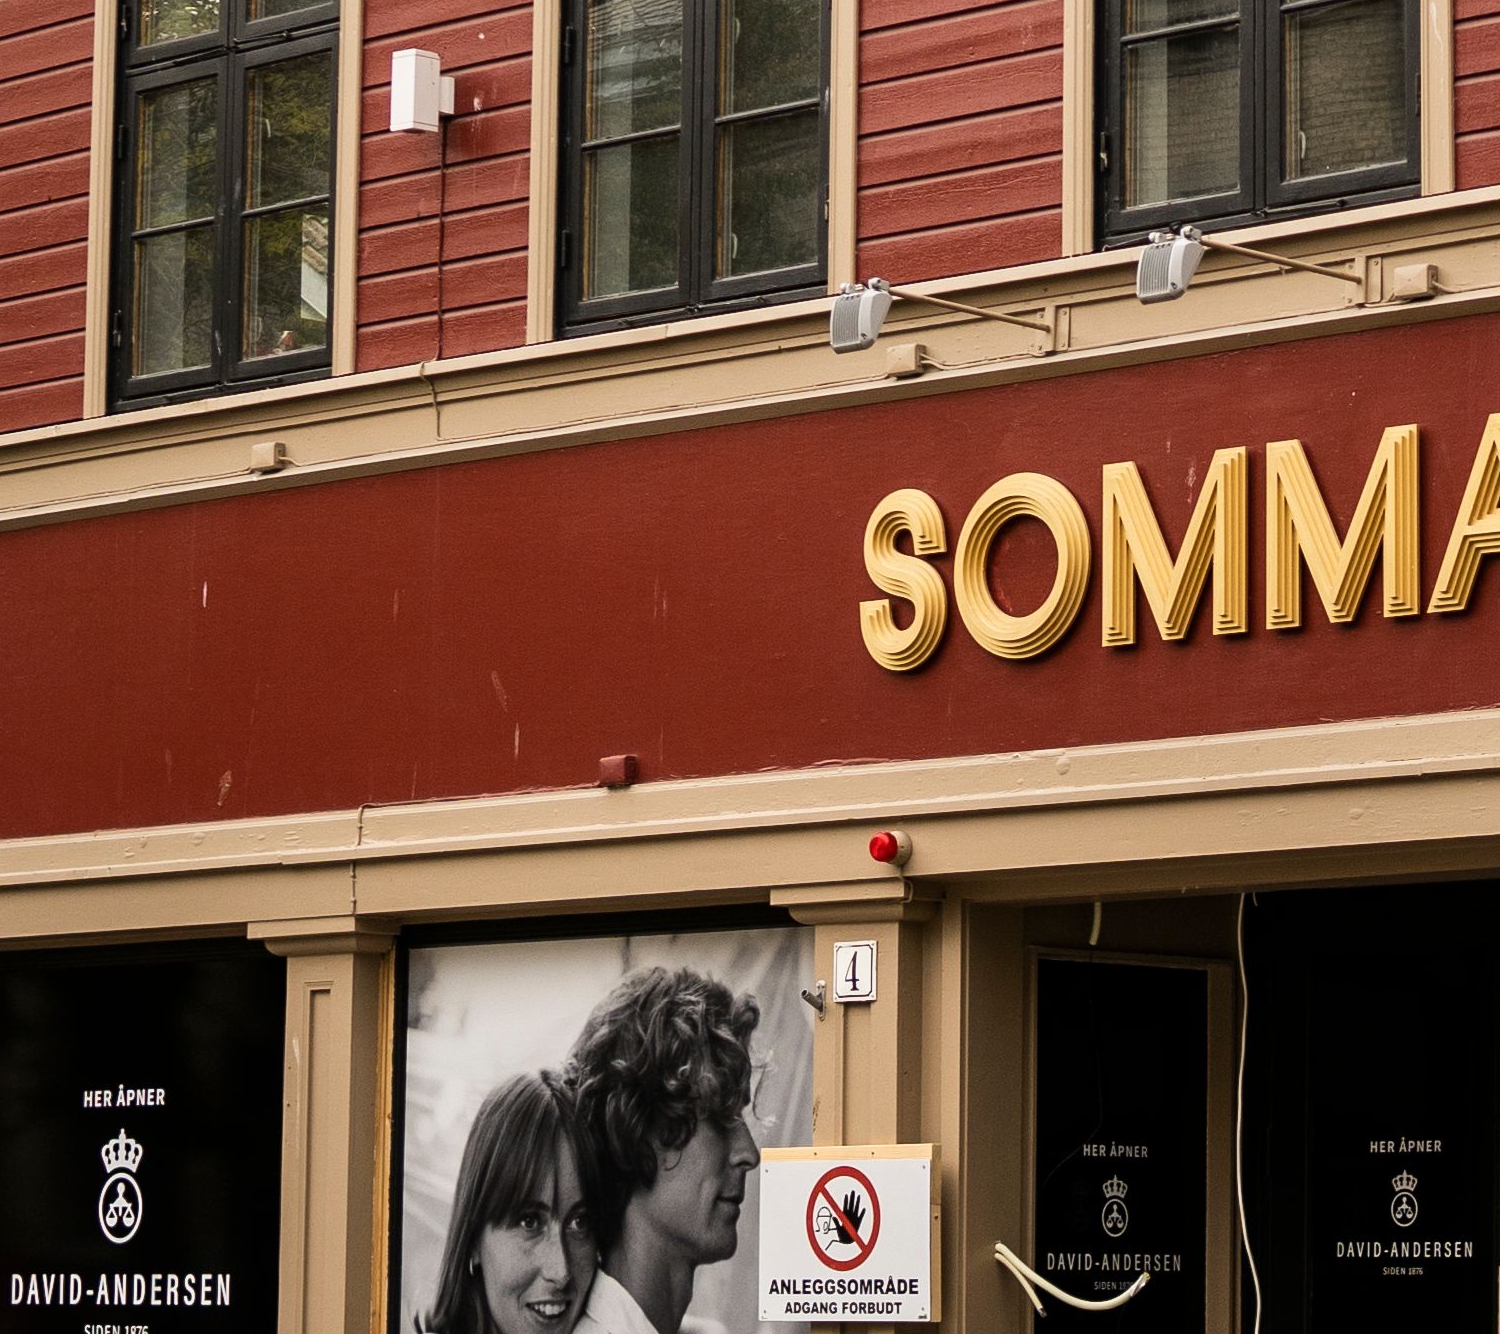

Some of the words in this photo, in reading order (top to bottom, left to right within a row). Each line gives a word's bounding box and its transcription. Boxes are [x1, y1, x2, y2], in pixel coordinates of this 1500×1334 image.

[844, 951, 860, 992] 4
[83, 1089, 112, 1108] HER
[115, 1083, 166, 1107] ÅPNER
[1083, 1144, 1107, 1157] HER
[1109, 1140, 1148, 1158] ÅPNER
[1370, 1140, 1395, 1153] HER
[1398, 1136, 1442, 1153] ÅPNER
[1336, 1241, 1473, 1258] DAVID-ANDERSEN
[1047, 1253, 1181, 1272] DAVID-ANDERSEN
[1382, 1267, 1406, 1276] SIDEN
[1408, 1267, 1424, 1276] 1876
[11, 1273, 232, 1306] DAVID-ANDERSEN
[768, 1275, 920, 1296] ANLEGGSOMRÅDE
[1094, 1281, 1117, 1291] SIDEN
[784, 1301, 838, 1316] ADGANG
[842, 1300, 903, 1315] FORBUDT
